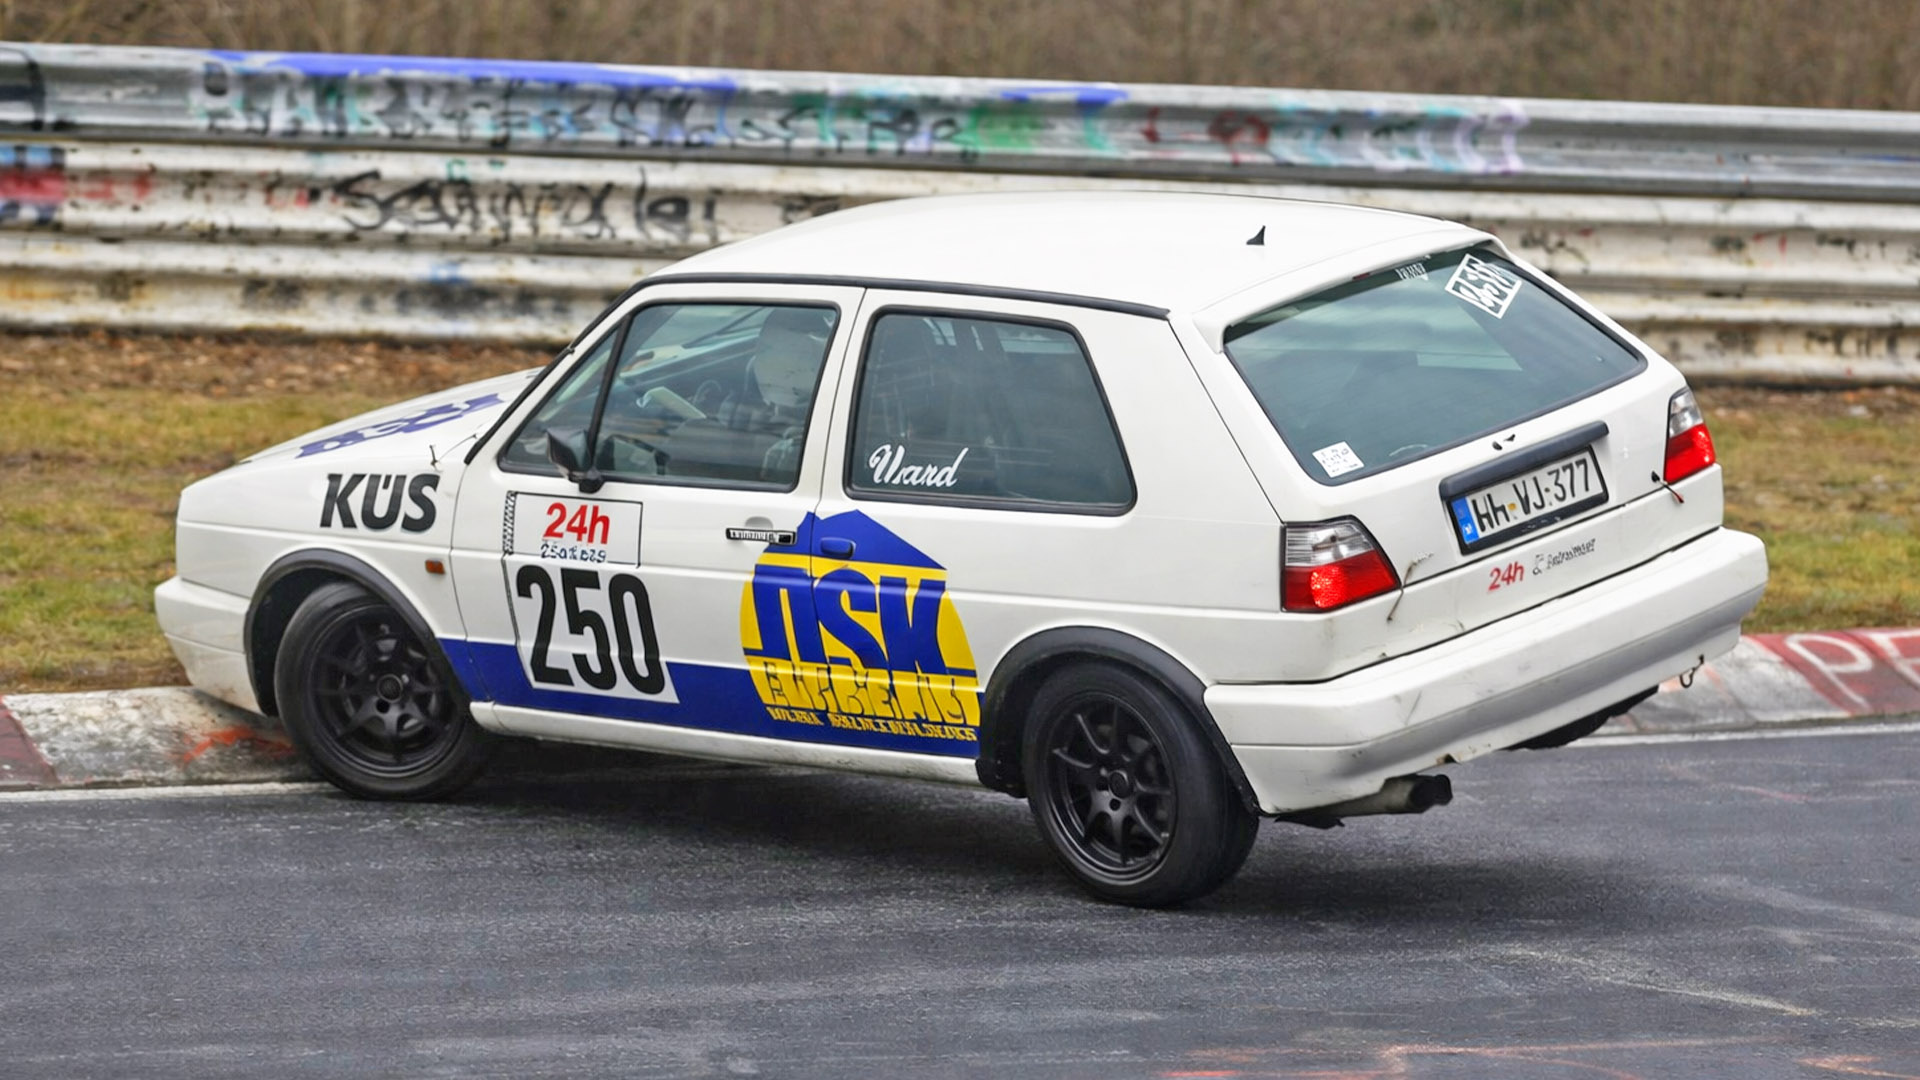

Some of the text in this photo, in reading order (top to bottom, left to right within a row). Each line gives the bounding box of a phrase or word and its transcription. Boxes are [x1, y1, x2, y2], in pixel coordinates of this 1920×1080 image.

[320, 473, 440, 532] KÜS
[543, 502, 610, 544] 24h
[1488, 561, 1525, 591] 24h
[516, 565, 665, 695] 250
